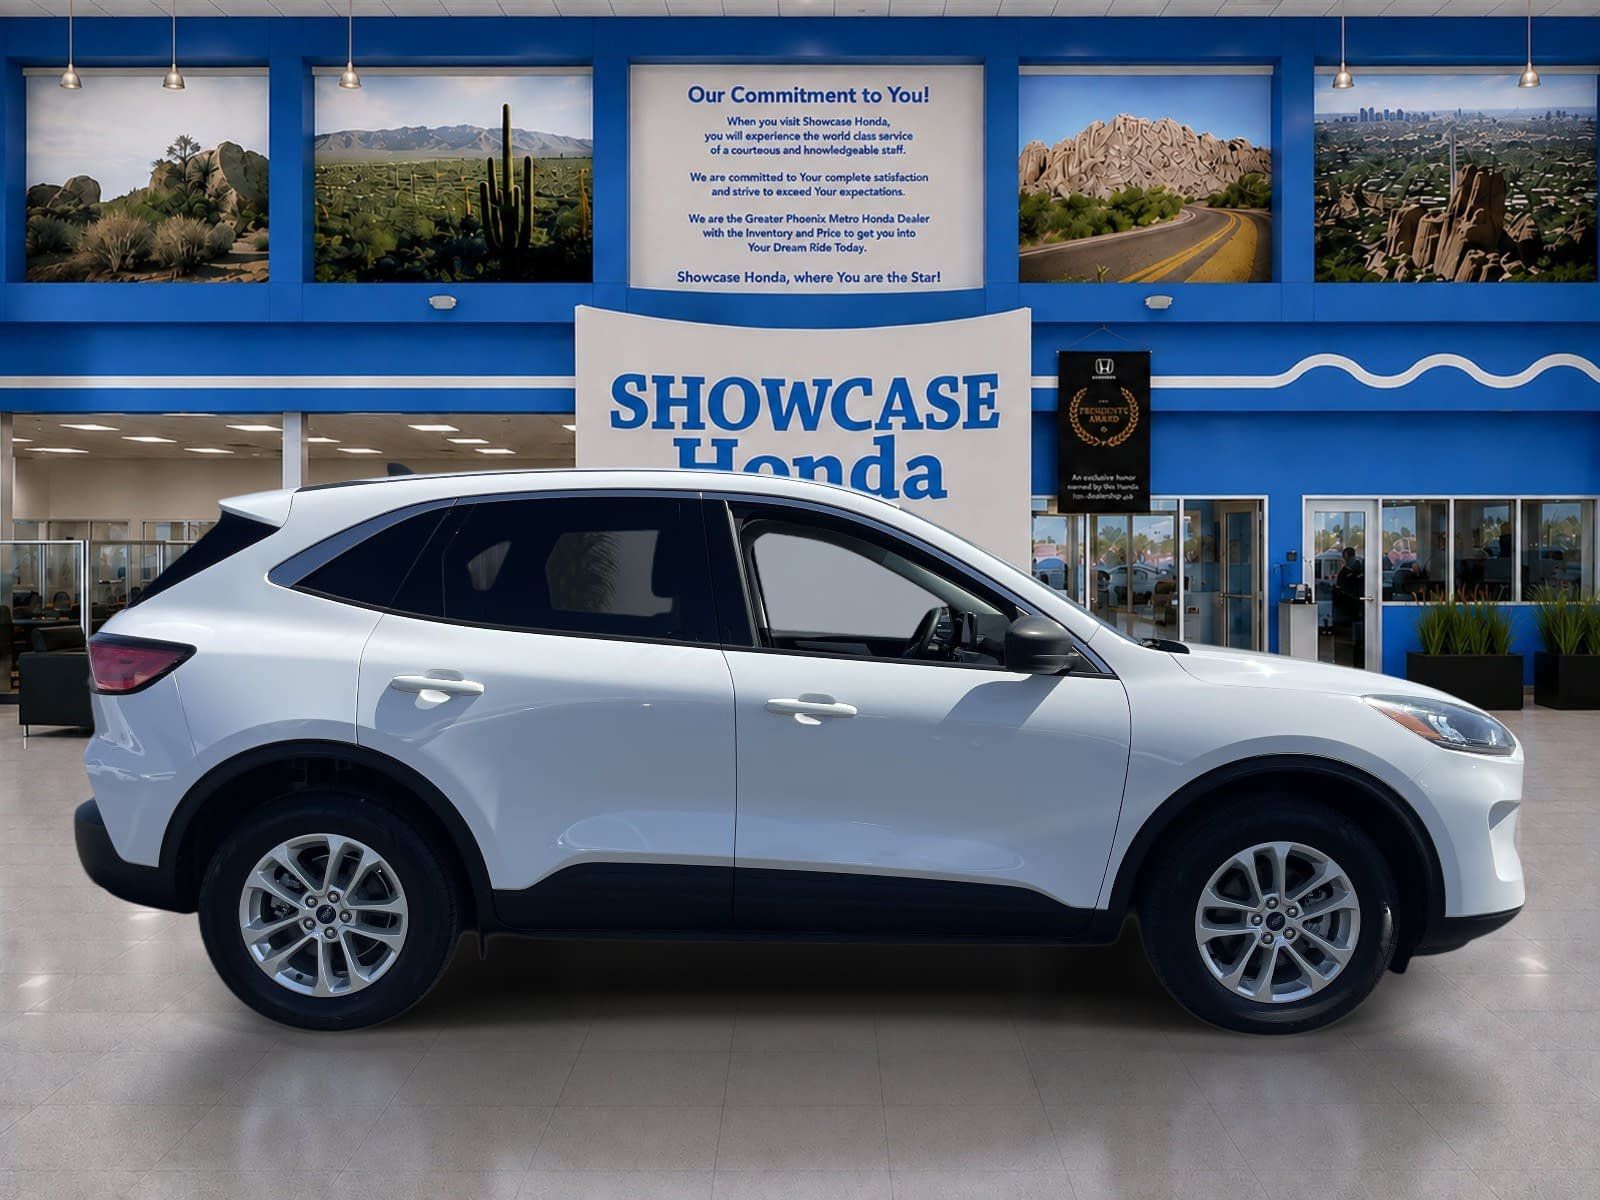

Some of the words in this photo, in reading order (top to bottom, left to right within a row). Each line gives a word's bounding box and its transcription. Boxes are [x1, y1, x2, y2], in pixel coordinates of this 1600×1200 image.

[687, 85, 727, 104] Our
[730, 85, 858, 104] Commitment
[860, 87, 884, 104] to
[886, 85, 930, 104] You!
[727, 116, 756, 127] When
[759, 118, 777, 129] you
[779, 116, 801, 127] visit
[803, 116, 852, 127] Showcase
[855, 116, 890, 128] Honda,
[704, 133, 723, 144] you
[725, 130, 743, 141] will
[745, 130, 801, 144] experience
[803, 130, 820, 141] the
[822, 130, 851, 142] world
[853, 130, 877, 141] class
[878, 130, 913, 142] service
[710, 144, 721, 155] of
[723, 147, 729, 155] a
[731, 146, 781, 156] courteous
[783, 144, 801, 155] and
[881, 144, 906, 155] staff.
[690, 172, 707, 183] We
[709, 174, 726, 182] are
[728, 171, 783, 183] committed
[786, 173, 797, 183] to
[799, 172, 822, 183] Your
[825, 172, 871, 185] complete
[874, 171, 929, 183] satisfaction
[711, 186, 731, 197] and
[732, 186, 760, 197] strive
[763, 187, 774, 197] to
[776, 186, 812, 197] exceed
[814, 186, 838, 197] Your
[839, 186, 905, 200] expectations.
[688, 213, 706, 224] We
[708, 215, 724, 224] are
[726, 213, 743, 224] the
[745, 213, 784, 224] Greater
[786, 213, 826, 224] Phoenix
[829, 213, 859, 224] Metro
[862, 213, 895, 224] Honda
[897, 213, 930, 224] Dealer
[702, 227, 725, 238] with
[727, 227, 744, 238] the
[746, 227, 793, 241] Inventory
[795, 227, 814, 238] and
[817, 227, 841, 238] Price
[844, 229, 855, 238] to
[857, 229, 874, 241] get
[876, 230, 895, 241] you
[897, 227, 916, 238] into
[748, 242, 771, 253] Your
[773, 242, 807, 253] Dream
[809, 242, 832, 253] Ride
[834, 242, 867, 255] Today.
[677, 270, 741, 284] Showcase
[744, 270, 790, 286] Honda,
[793, 270, 834, 284] where
[836, 271, 860, 284] You
[864, 274, 883, 284] are
[886, 270, 908, 284] the
[911, 271, 941, 284] Star!
[610, 373, 1000, 431] SHOWCASE
